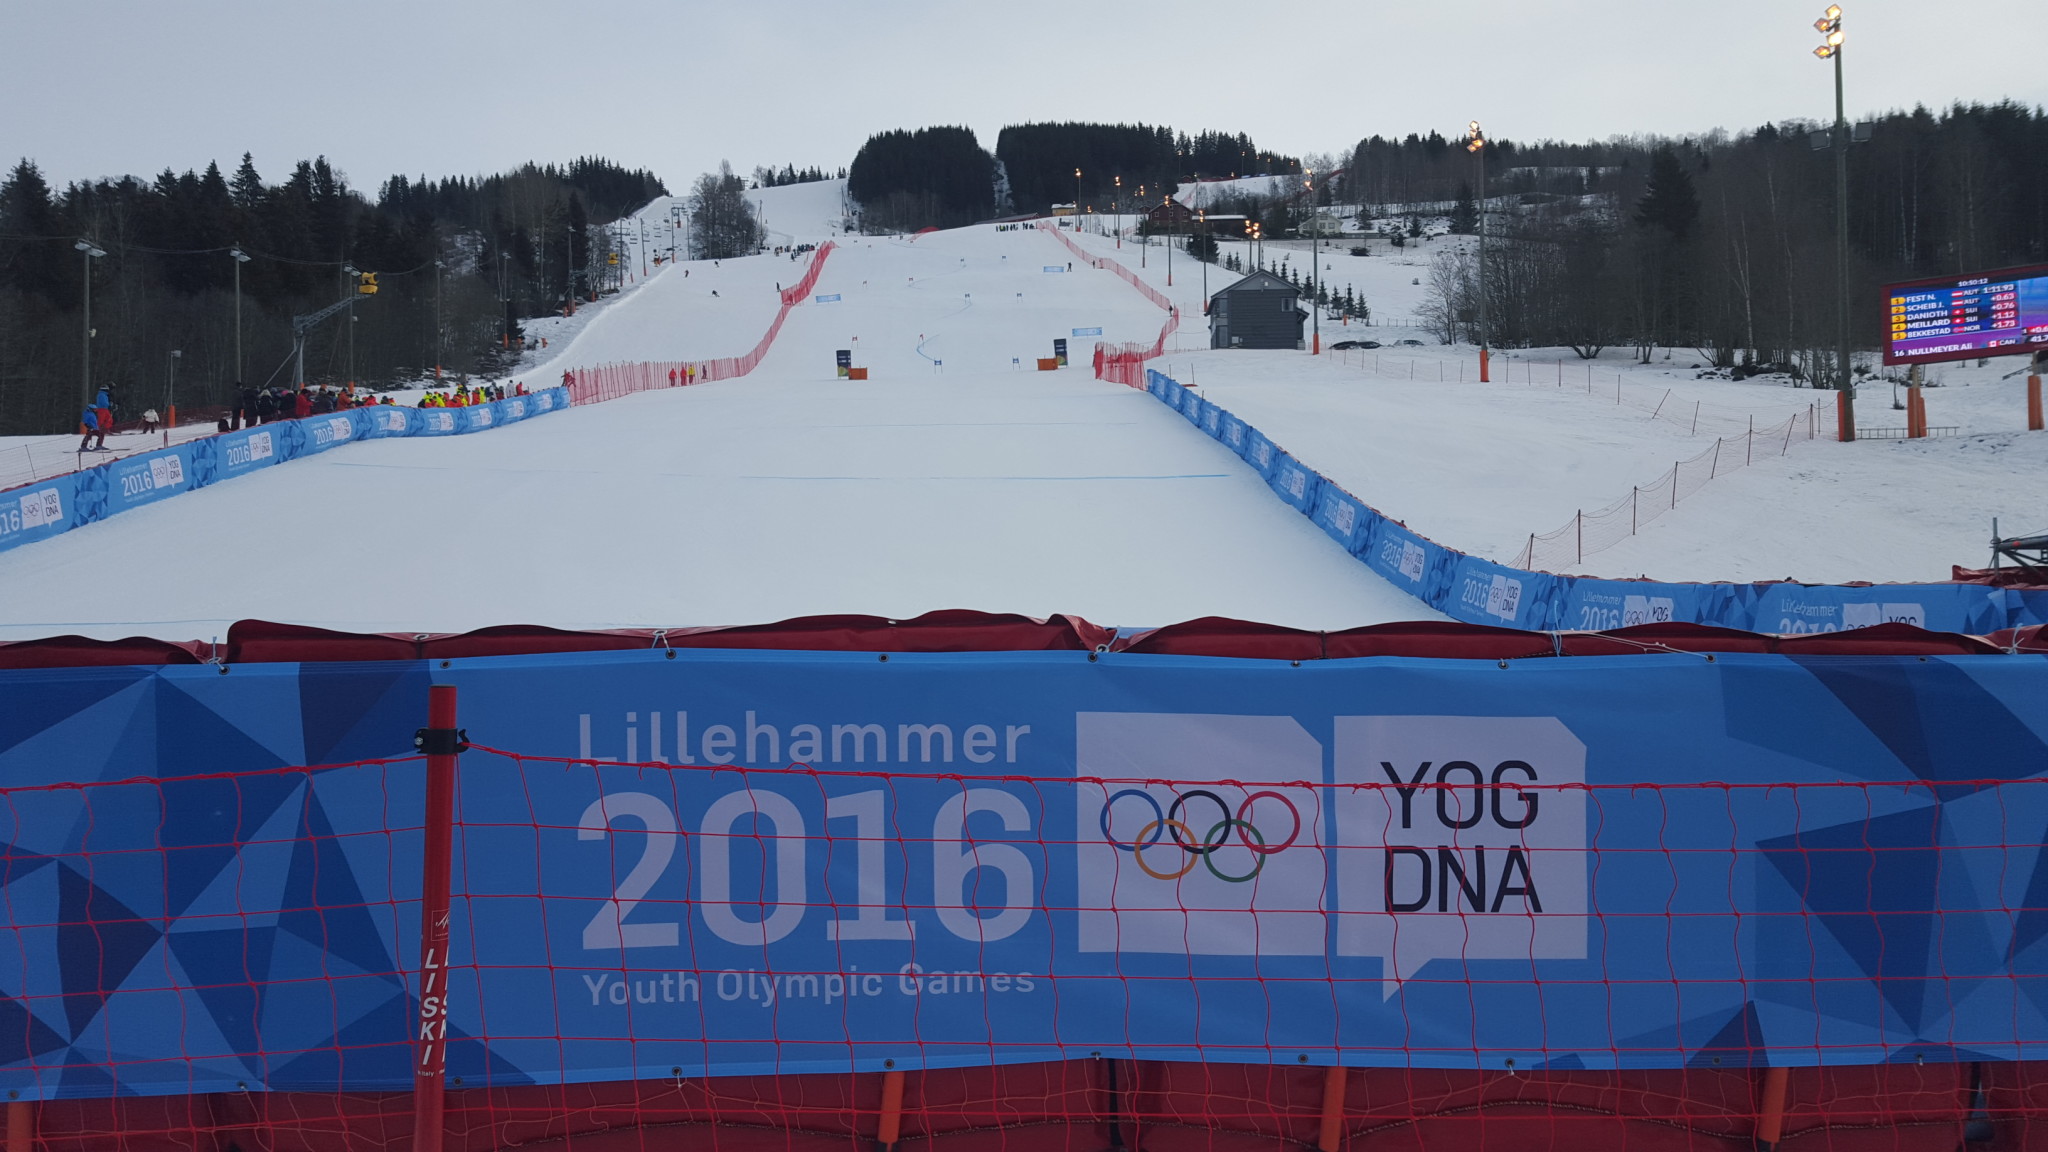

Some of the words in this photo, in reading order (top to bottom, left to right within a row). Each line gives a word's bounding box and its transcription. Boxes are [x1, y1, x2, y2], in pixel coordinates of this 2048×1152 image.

[1906, 295, 1926, 303] FEST
[1906, 303, 1937, 312] SCHEIB
[1991, 293, 2014, 301] +0.63
[1907, 310, 1948, 321] DANIOTH
[1907, 319, 1951, 329] MEILLARD
[1991, 311, 2015, 319] +1.12
[1907, 328, 1951, 338] BEKKESTAD
[1992, 320, 2015, 328] +1.73
[1908, 344, 1959, 356] NULLMEYER
[313, 426, 333, 445] 2016
[226, 445, 250, 466] 2016
[121, 471, 152, 497] 2016
[43, 493, 57, 505] YOG
[45, 505, 60, 517] DNA
[0, 509, 20, 535] 16
[1381, 540, 1402, 568] 2016
[1461, 578, 1489, 609] 2016
[1506, 585, 1519, 600] YOG
[1502, 598, 1515, 613] DNA
[579, 710, 1031, 768] Lillehammer
[1380, 760, 1538, 829] YOG
[577, 787, 1035, 950] 2016
[1385, 845, 1543, 912] DNA
[582, 972, 699, 1007] Youth
[716, 966, 883, 1008] Olympic
[899, 963, 1035, 996] Games
[420, 948, 440, 1065] LISKI
